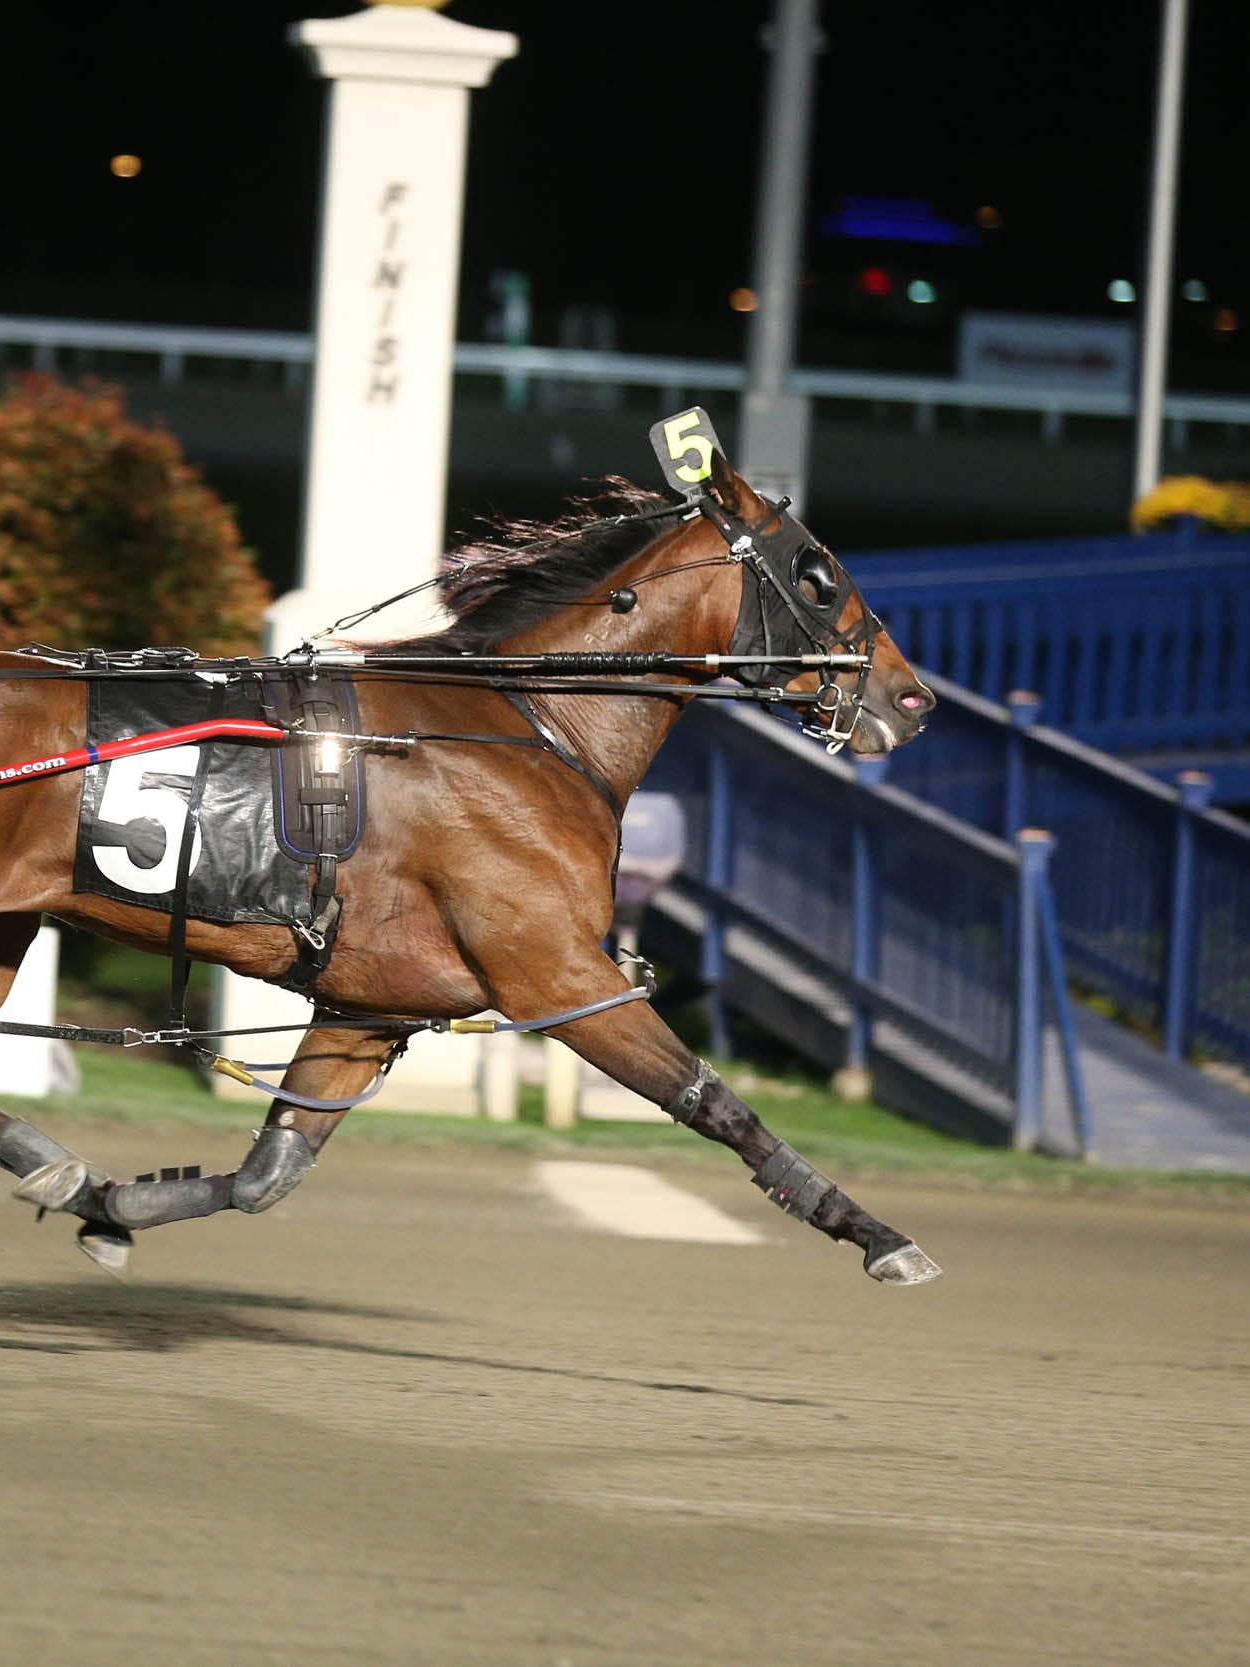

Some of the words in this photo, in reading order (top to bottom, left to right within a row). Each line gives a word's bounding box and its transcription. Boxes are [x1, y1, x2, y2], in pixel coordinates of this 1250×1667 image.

[366, 183, 409, 404] FINISH
[663, 411, 714, 483] 5
[91, 737, 203, 895] 5
